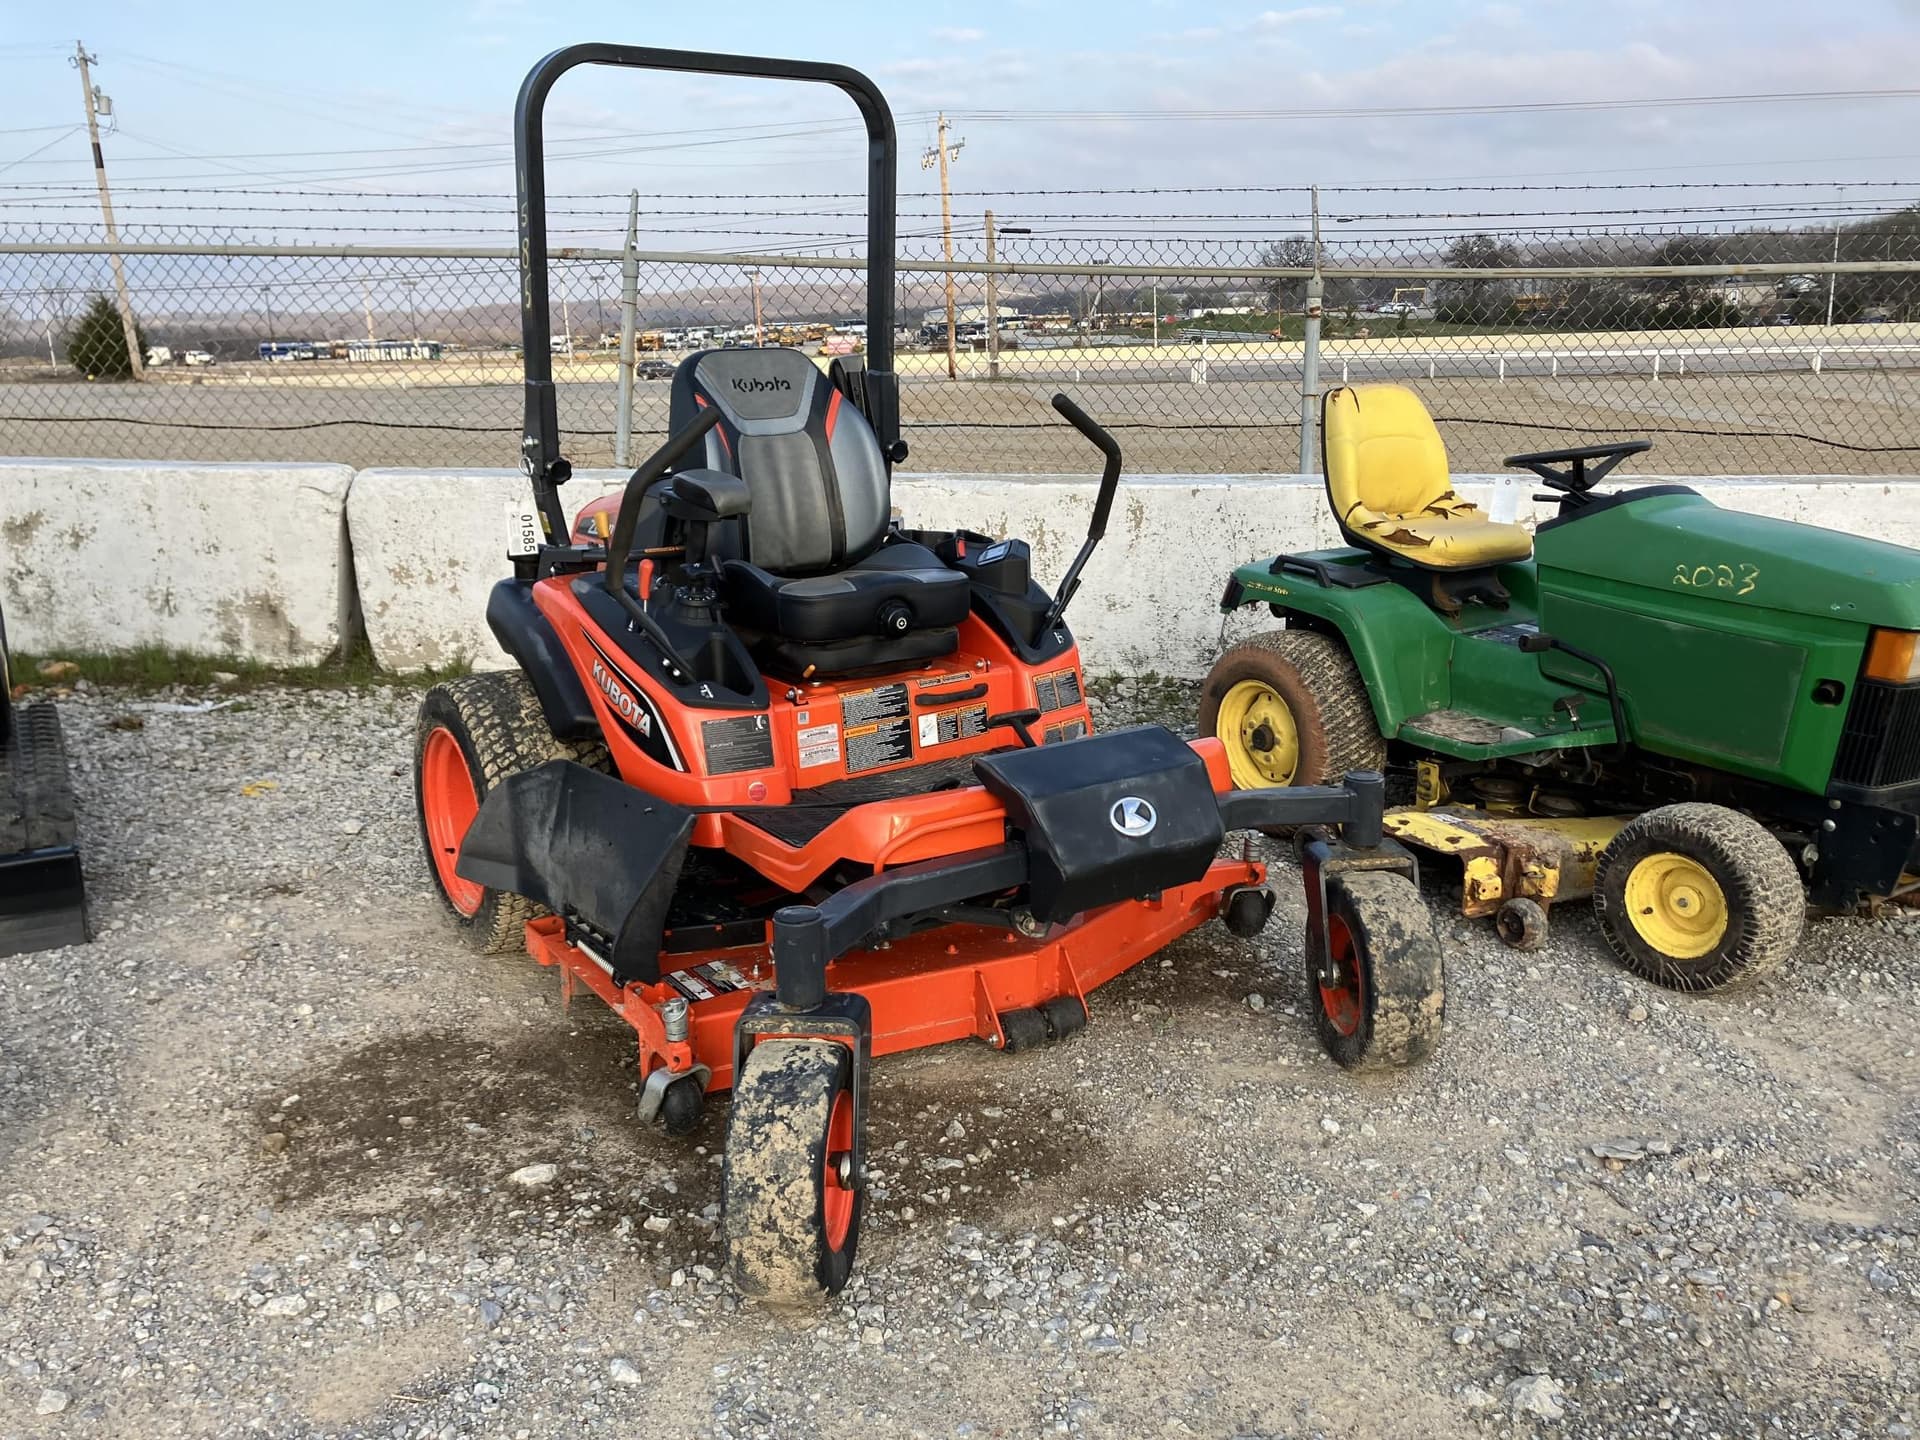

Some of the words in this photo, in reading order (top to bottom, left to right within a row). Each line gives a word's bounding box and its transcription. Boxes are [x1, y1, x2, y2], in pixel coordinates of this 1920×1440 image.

[519, 169, 532, 309] 1585
[731, 376, 791, 393] Kubota
[520, 514, 536, 553] 01585
[1672, 563, 1761, 596] 2023
[592, 659, 651, 739] KUBOTA
